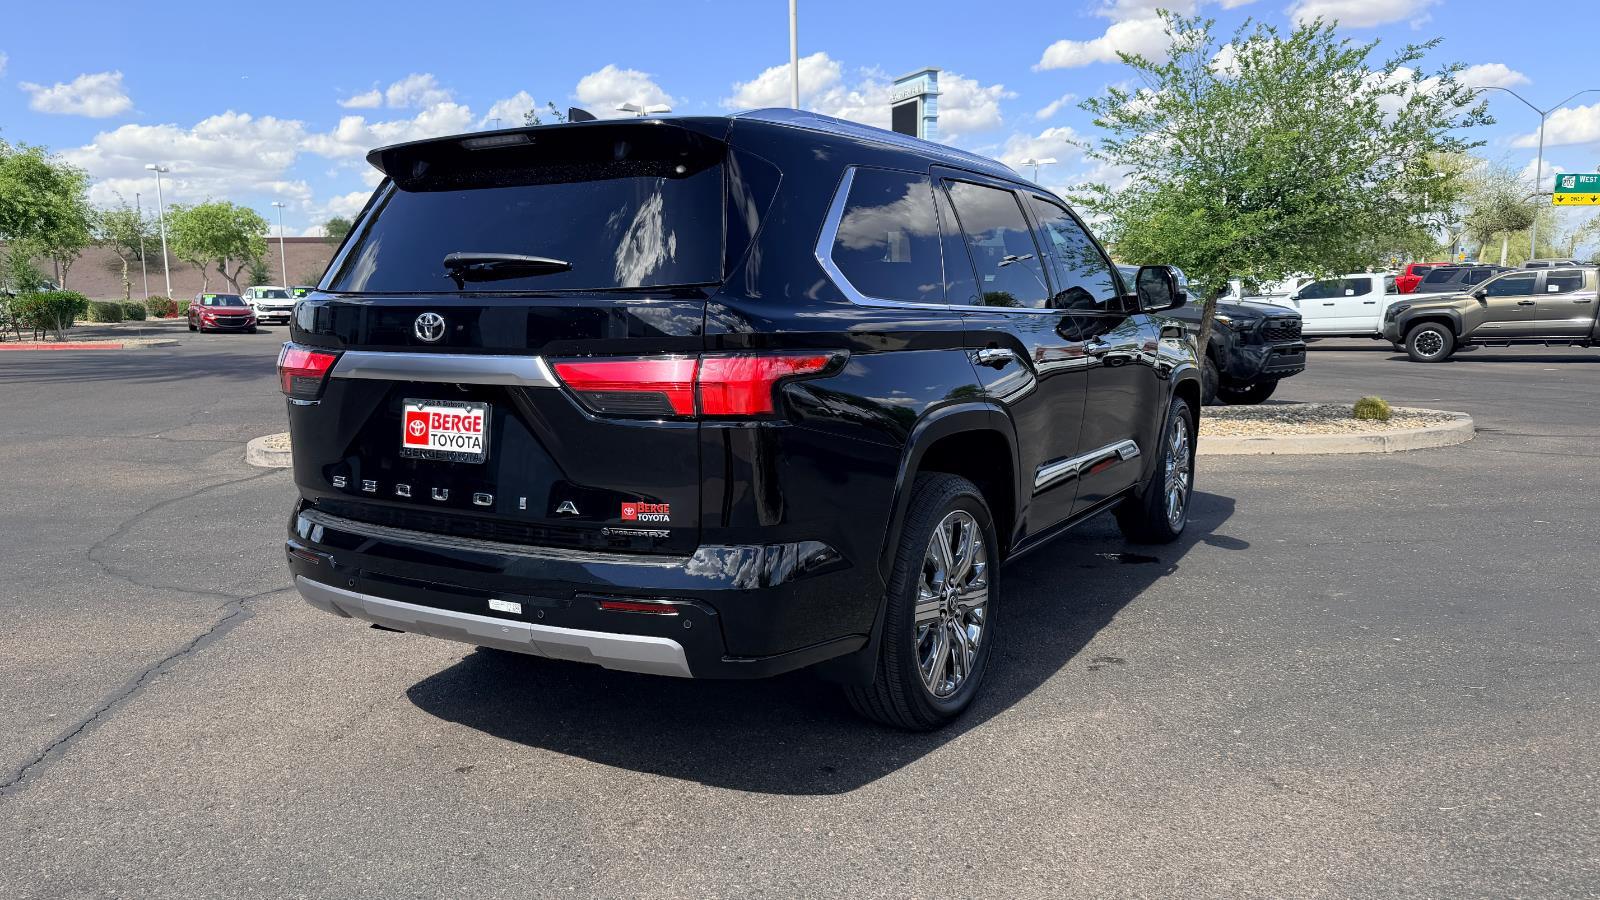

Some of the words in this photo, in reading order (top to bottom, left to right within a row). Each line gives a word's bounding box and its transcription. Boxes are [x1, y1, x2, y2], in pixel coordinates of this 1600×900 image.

[431, 412, 481, 432] BERGE
[431, 434, 481, 449] TOYOTA
[404, 448, 443, 460] BERGE
[333, 475, 580, 515] SEQUOIA
[638, 502, 670, 513] BERGE
[638, 513, 670, 521] TOYOTA
